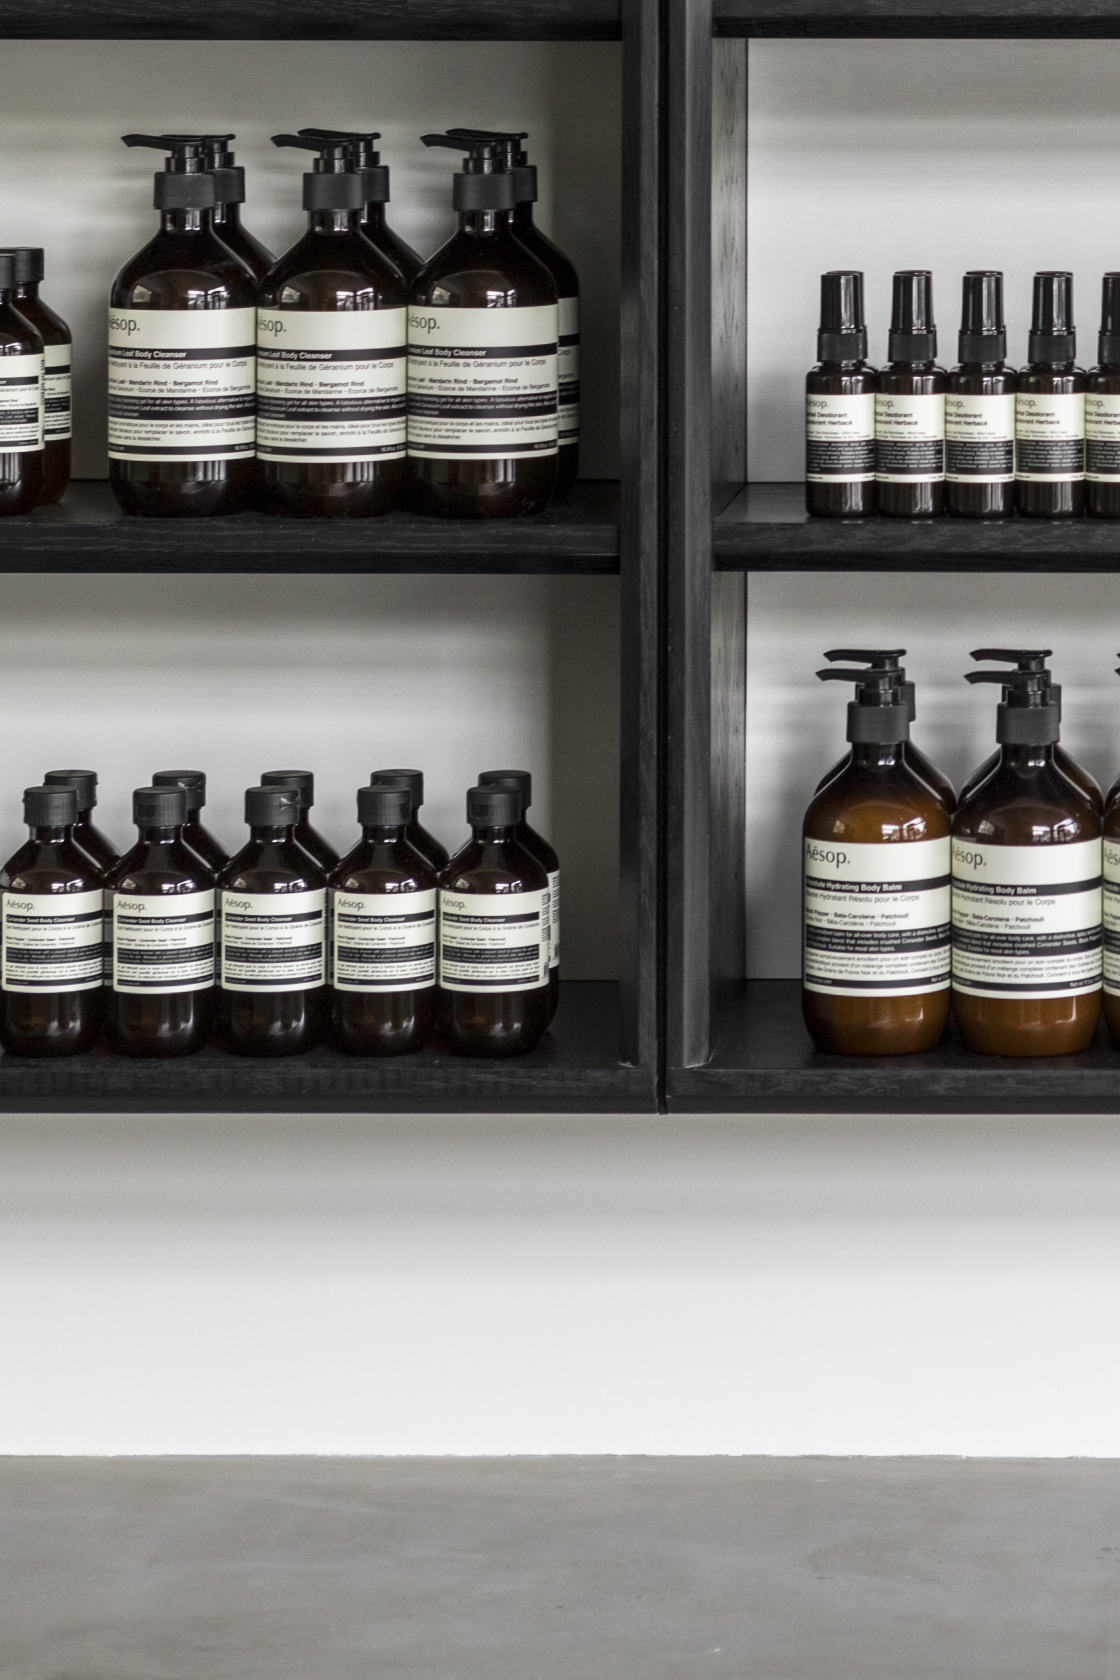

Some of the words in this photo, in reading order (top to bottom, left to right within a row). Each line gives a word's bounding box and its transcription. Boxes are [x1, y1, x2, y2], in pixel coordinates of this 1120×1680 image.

[134, 350, 152, 359] Body
[152, 350, 187, 358] Cleanser
[281, 351, 298, 360] Body
[826, 881, 860, 892] Hydrating
[860, 883, 881, 892] Body
[882, 883, 903, 891] Balm
